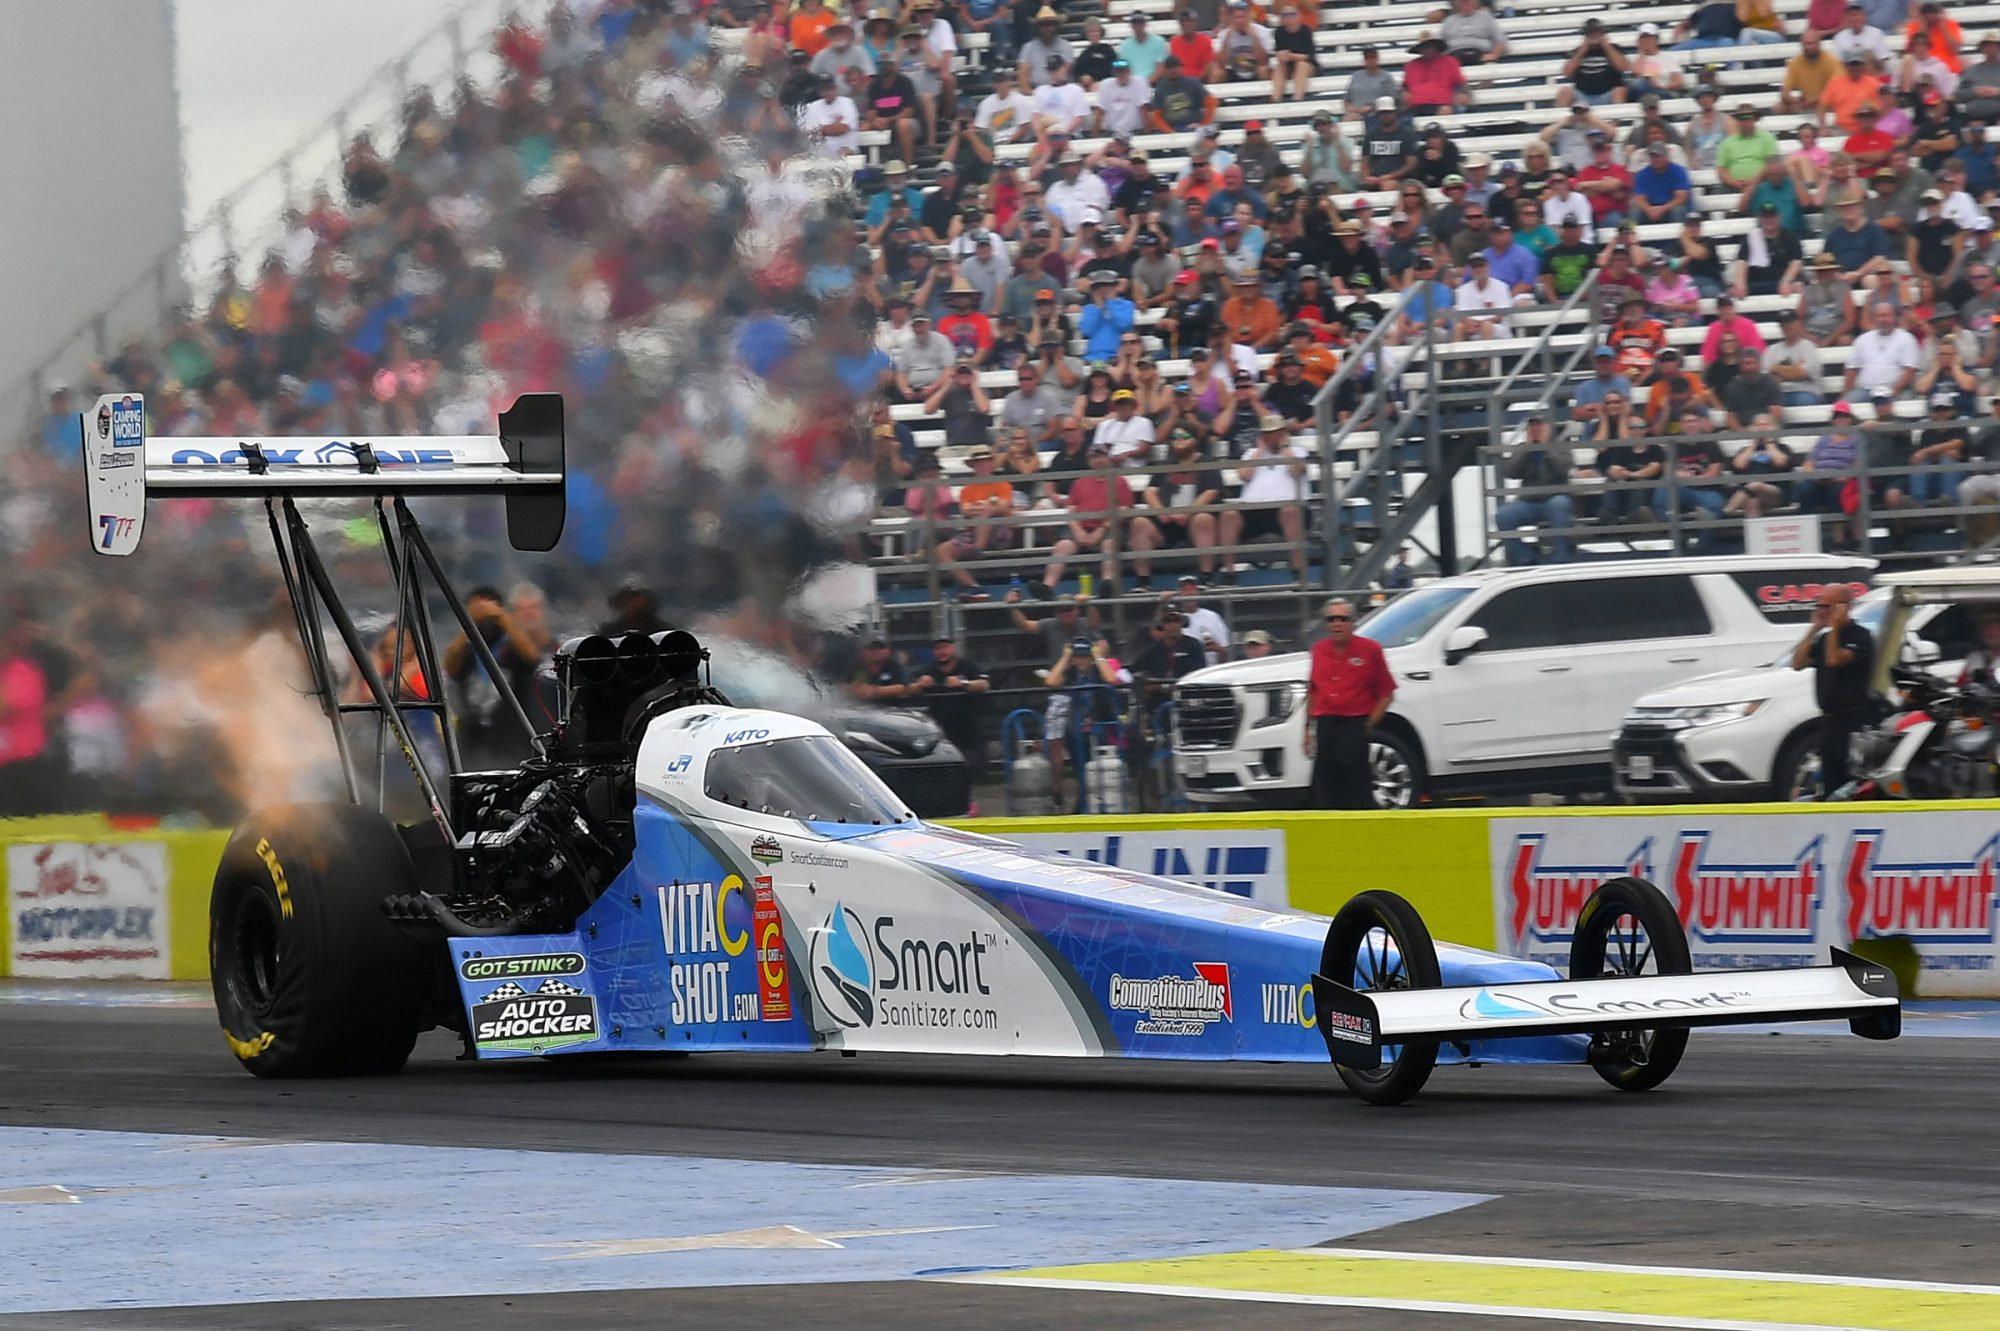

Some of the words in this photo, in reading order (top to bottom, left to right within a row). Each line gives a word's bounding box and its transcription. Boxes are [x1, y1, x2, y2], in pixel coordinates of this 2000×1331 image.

[114, 410, 141, 423] CAMPING
[114, 422, 141, 439] WORLD
[1757, 583, 1869, 602] CAPO
[723, 729, 770, 745] KATO
[467, 960, 505, 977] GOT
[1111, 974, 1226, 1011] CompetitionPlus
[499, 999, 566, 1020] AUTO
[880, 998, 998, 1030] Sanitizer.com
[478, 1014, 592, 1039] SHOCKER
[1135, 1021, 1183, 1034] Established
[1184, 1022, 1204, 1035] 1999
